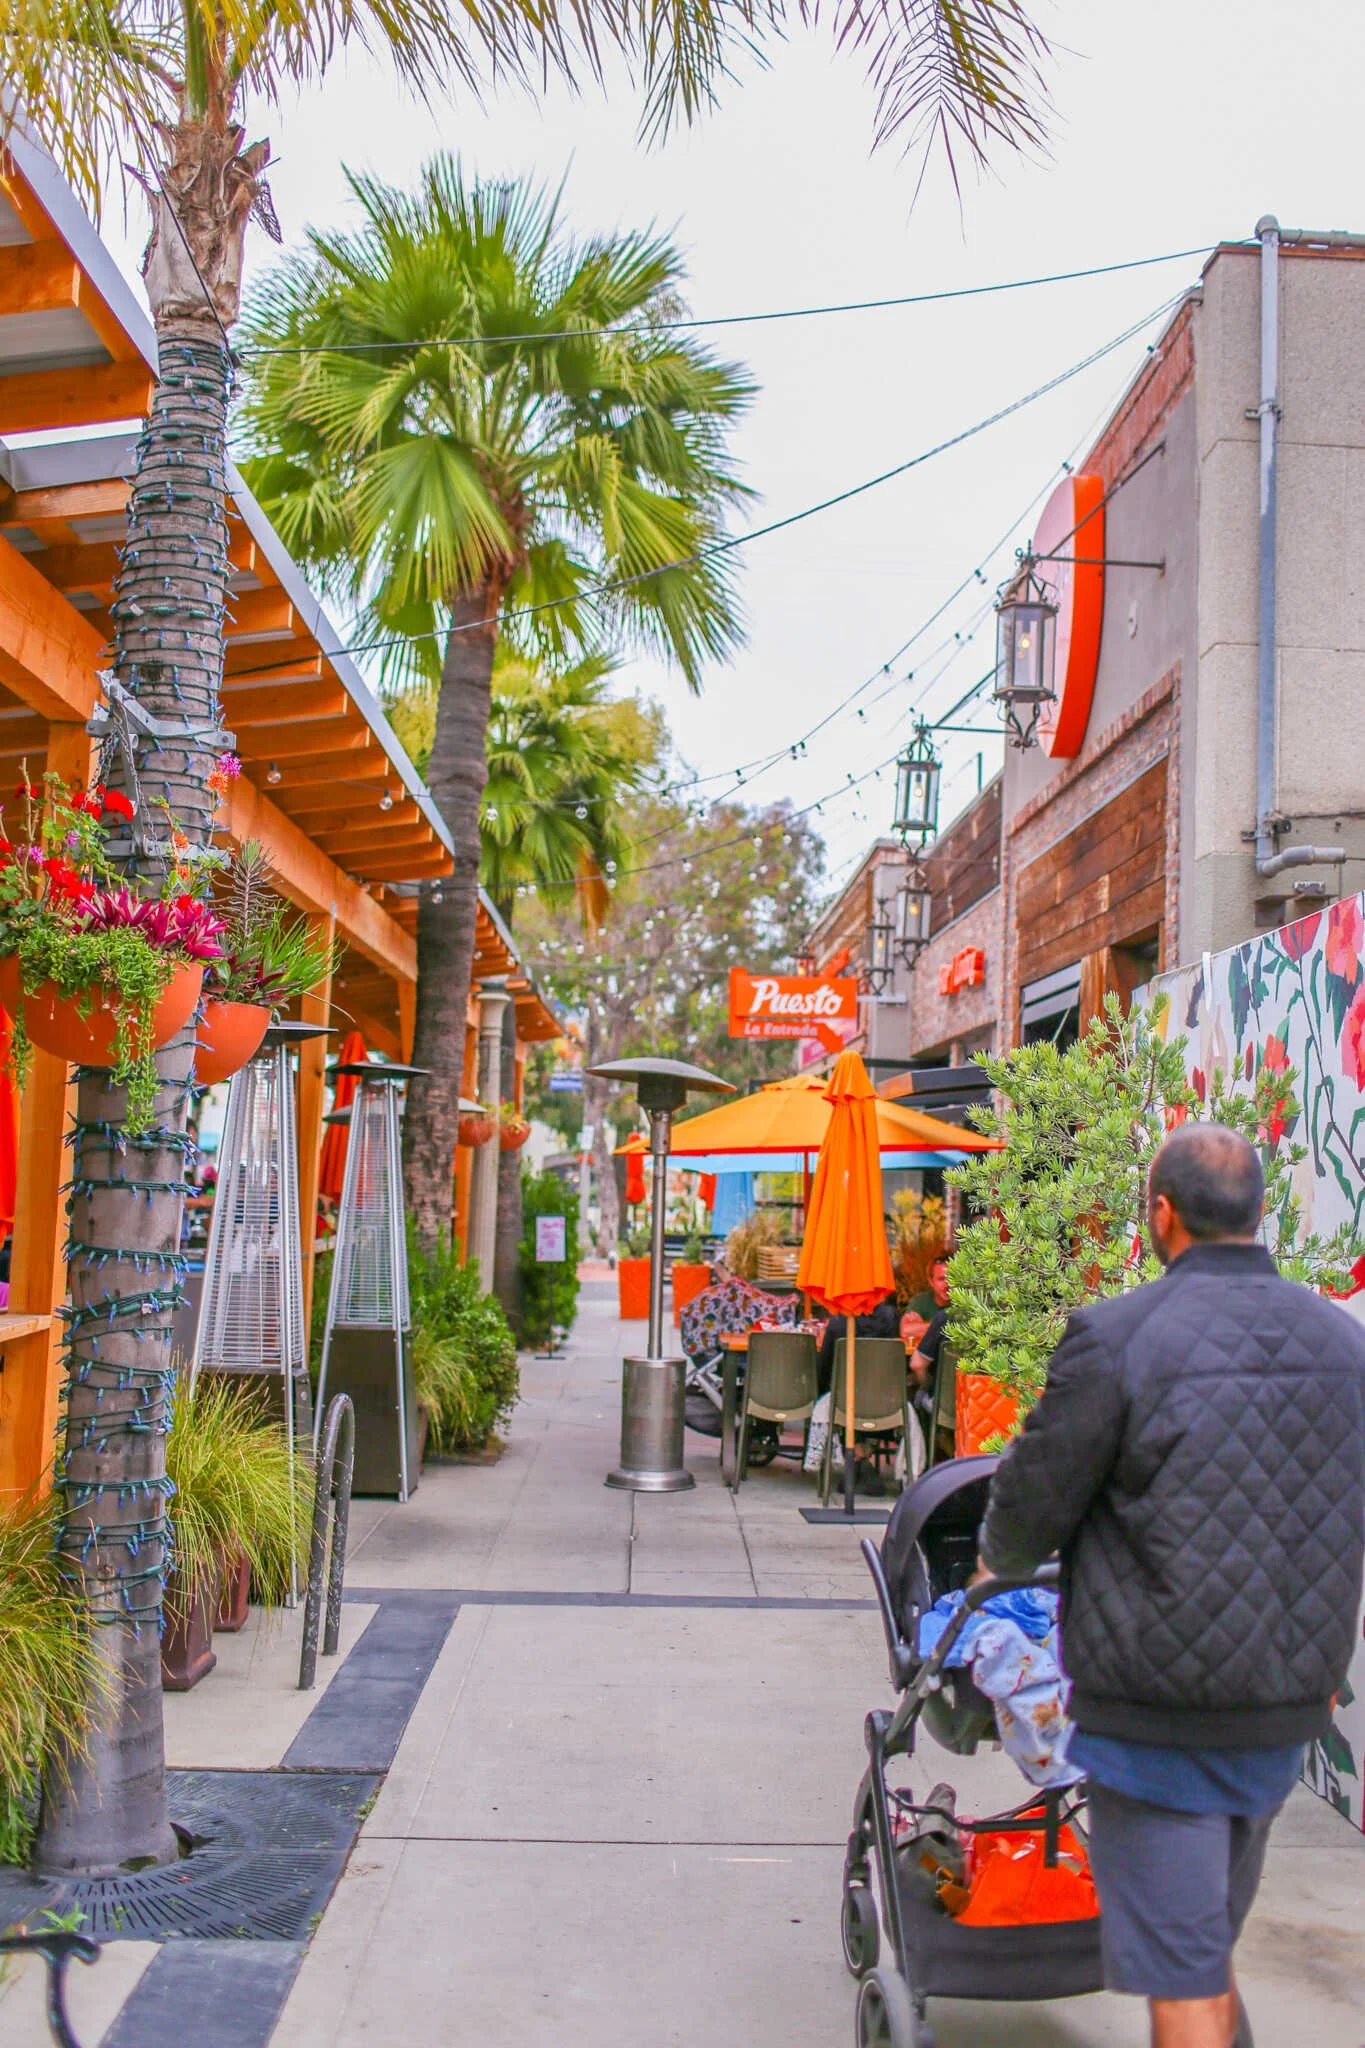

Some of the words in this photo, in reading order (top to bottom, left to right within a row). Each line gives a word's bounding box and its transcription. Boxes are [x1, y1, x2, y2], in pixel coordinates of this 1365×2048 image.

[749, 979, 843, 1015] Puesto
[744, 1022, 760, 1035] La
[764, 1022, 818, 1036] Entrada
